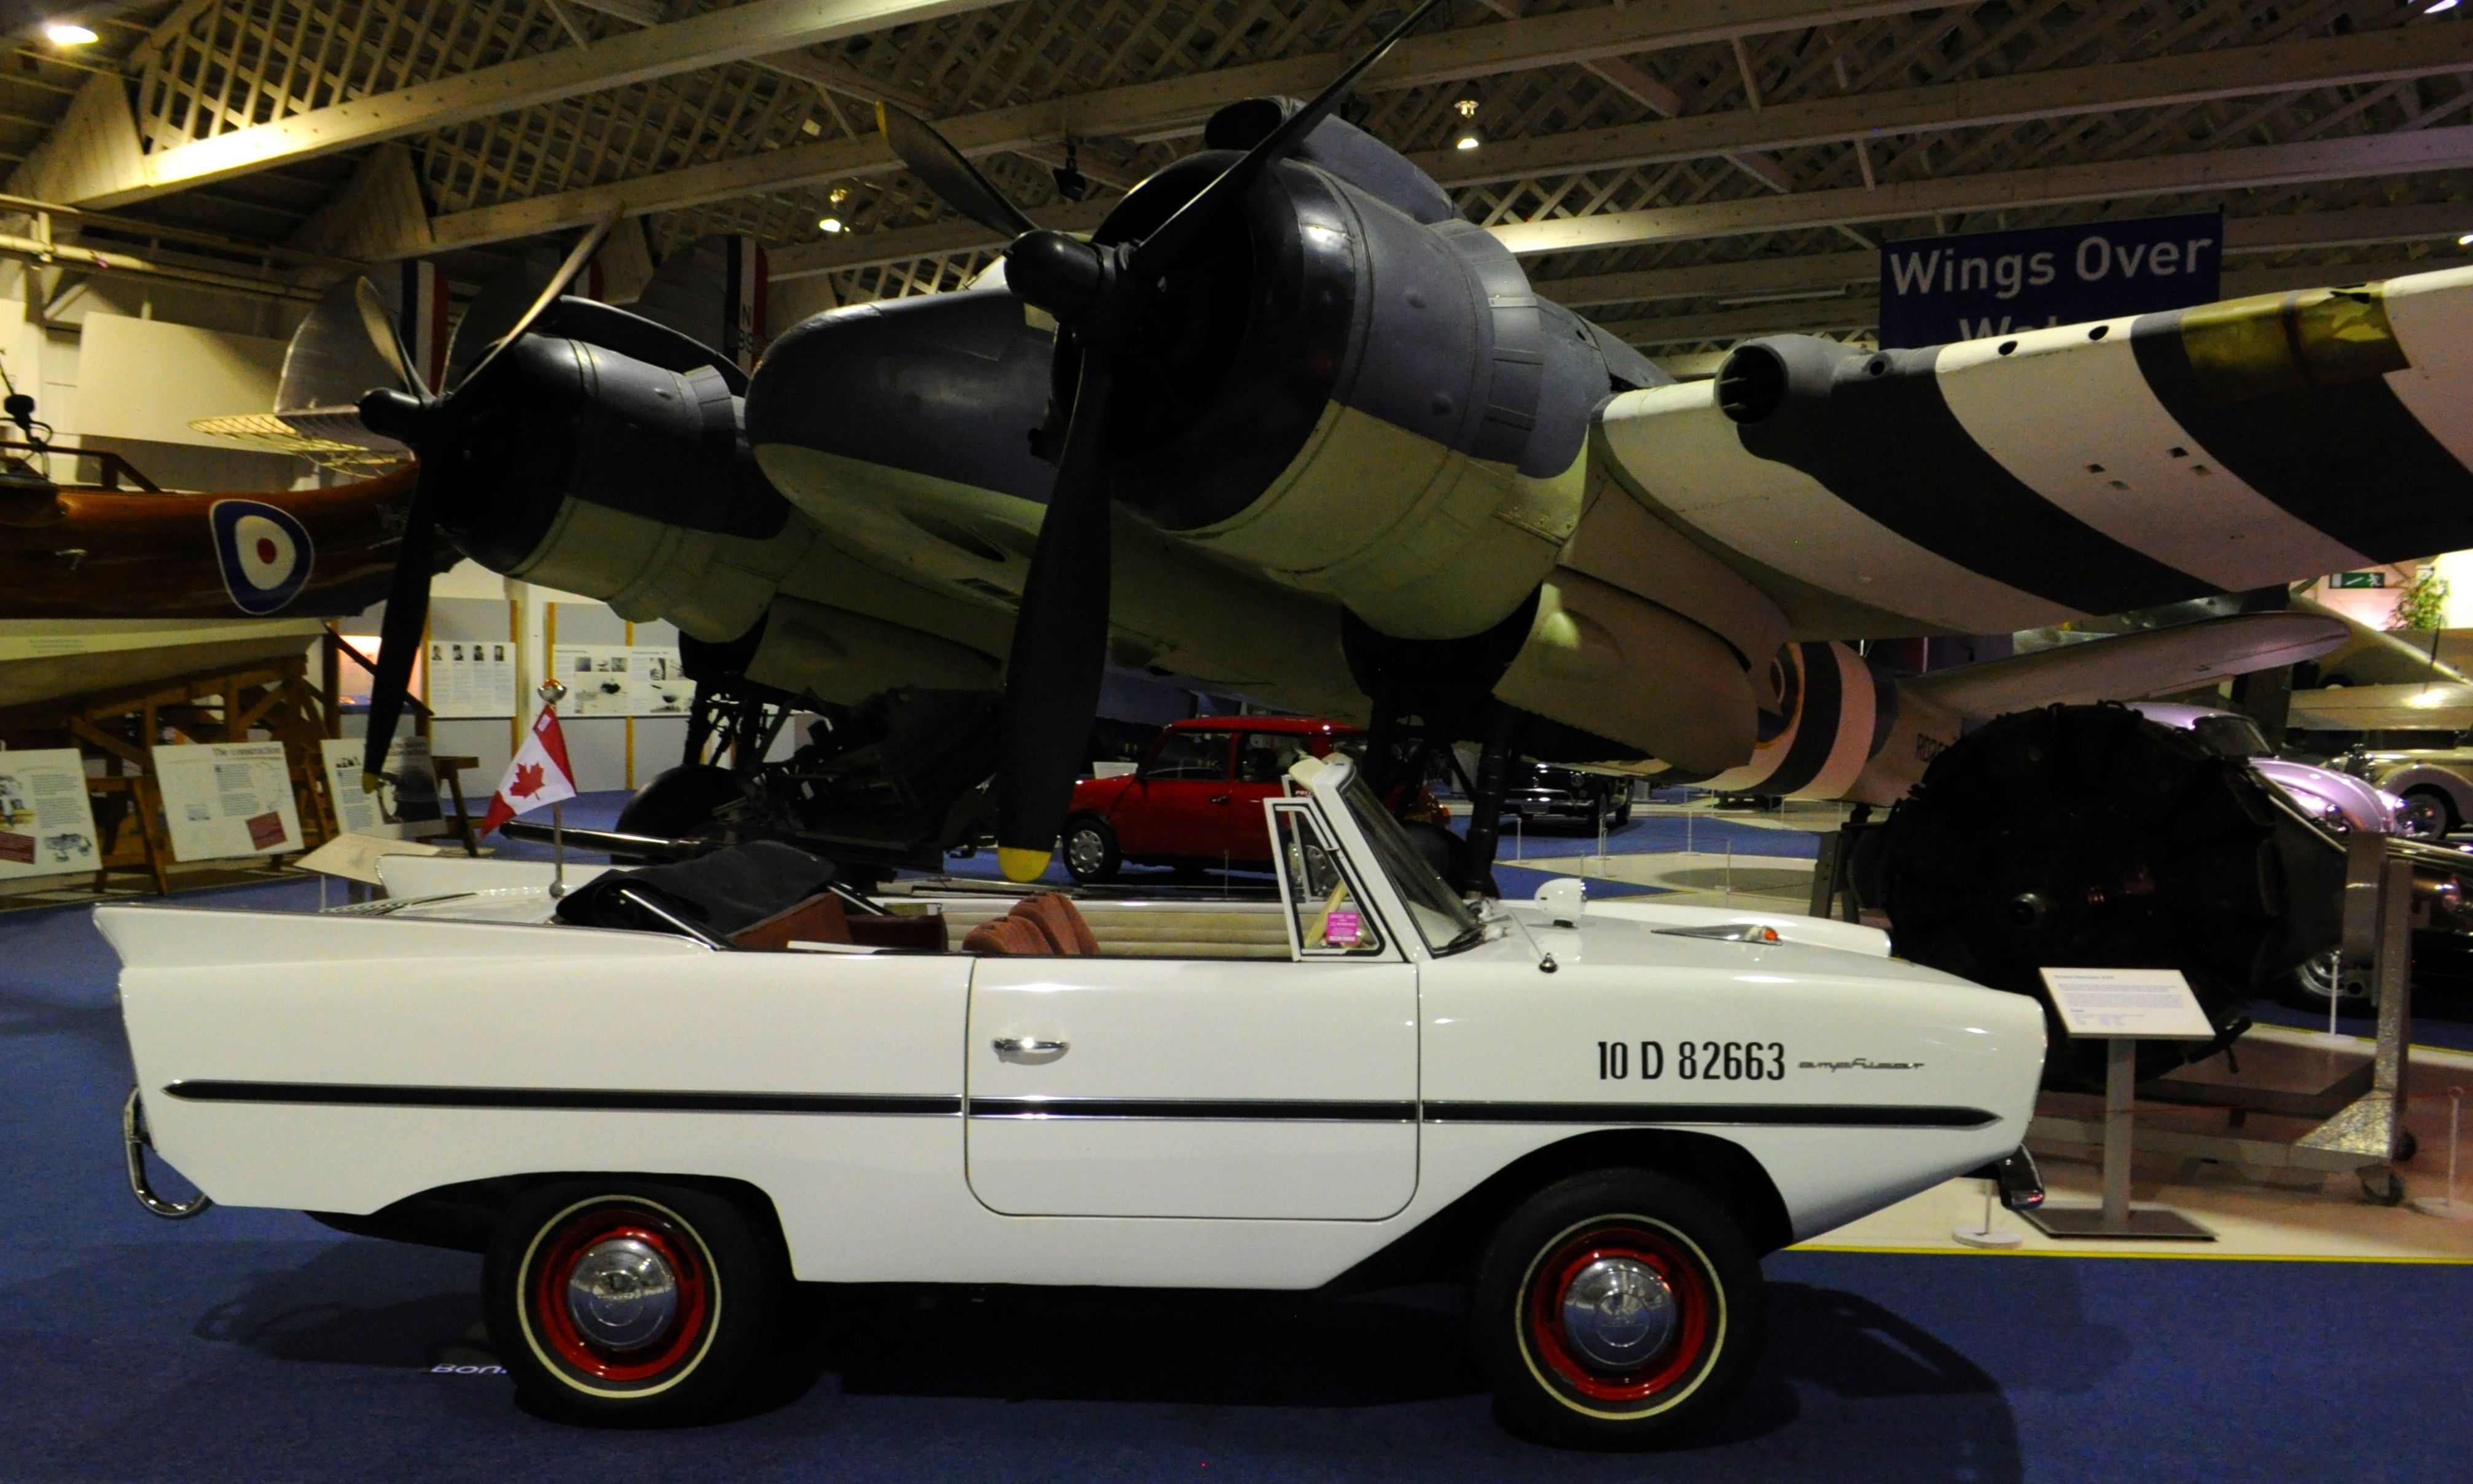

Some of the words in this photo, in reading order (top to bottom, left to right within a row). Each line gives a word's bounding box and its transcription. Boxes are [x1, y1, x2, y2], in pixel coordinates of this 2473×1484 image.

[1889, 247, 2057, 300] Wings
[2075, 235, 2214, 282] Over
[1598, 1041, 1628, 1079] 10
[1641, 1041, 1663, 1079] D
[1679, 1041, 1785, 1080] 82663
